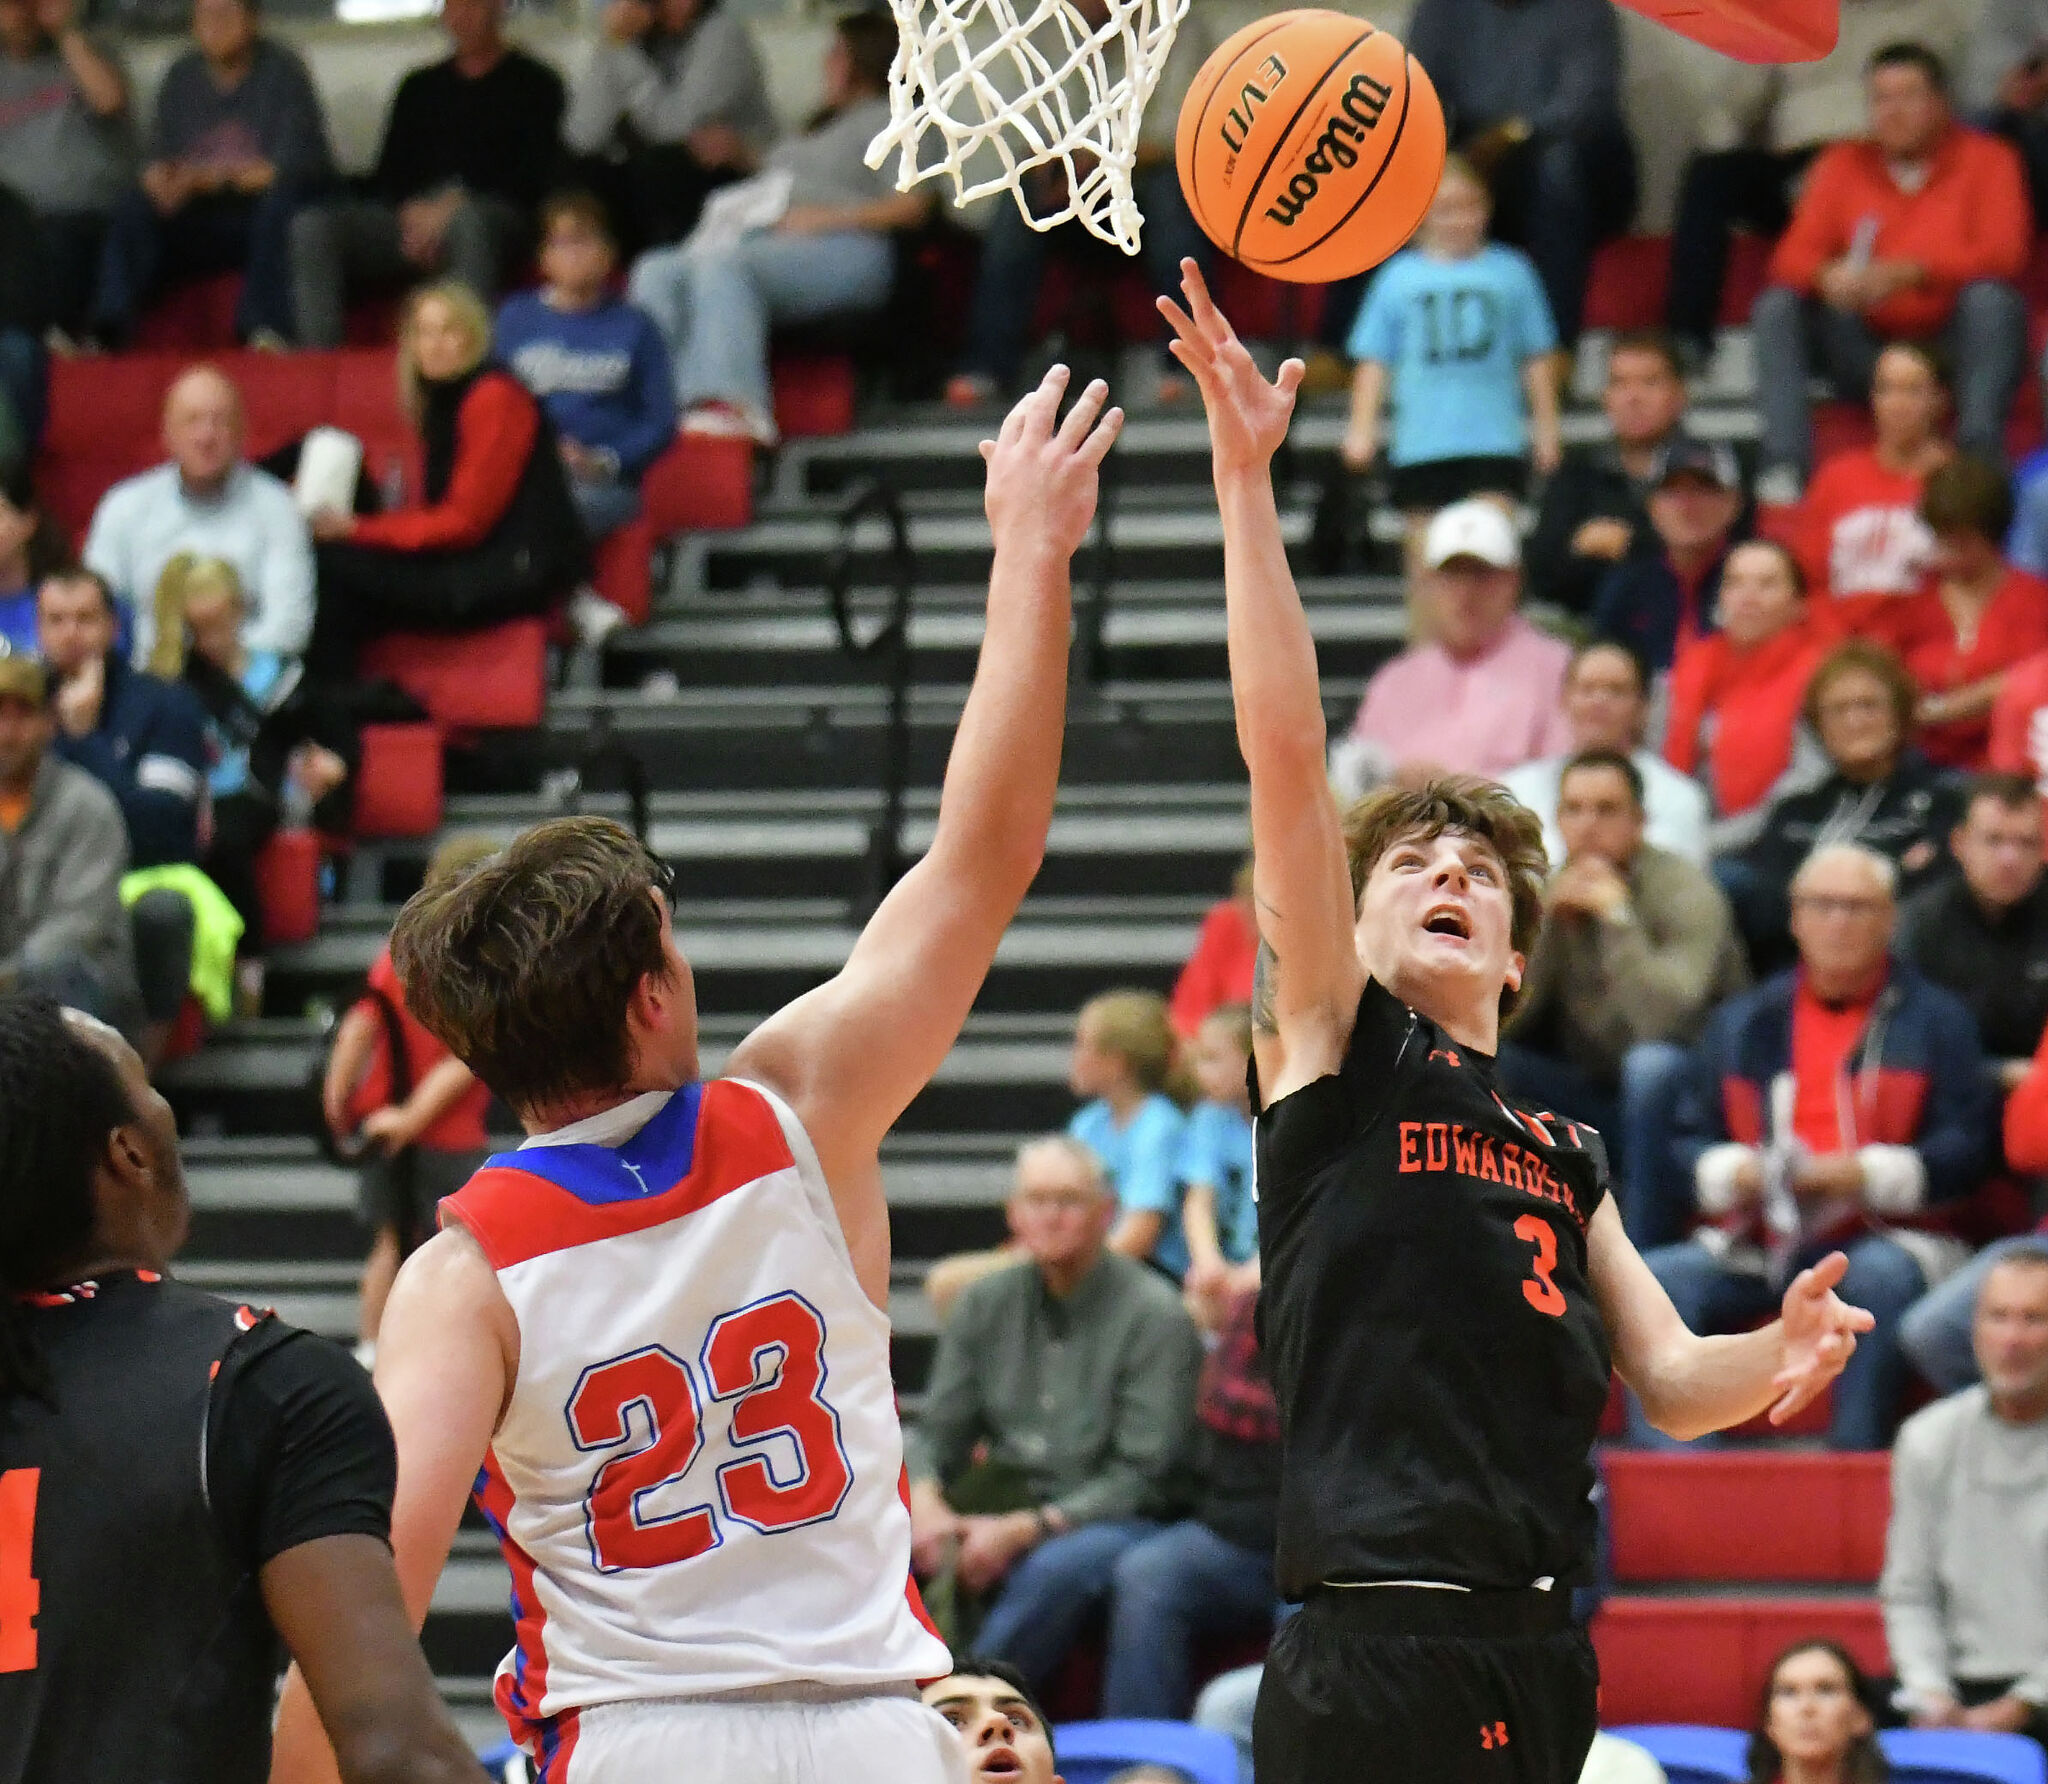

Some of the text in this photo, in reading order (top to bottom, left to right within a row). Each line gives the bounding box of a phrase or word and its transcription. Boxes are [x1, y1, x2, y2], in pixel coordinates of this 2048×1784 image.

[1220, 53, 1286, 154] EVO
[1265, 73, 1393, 226] Wilson
[1513, 1213, 1568, 1317] 3
[564, 1289, 854, 1574] 23
